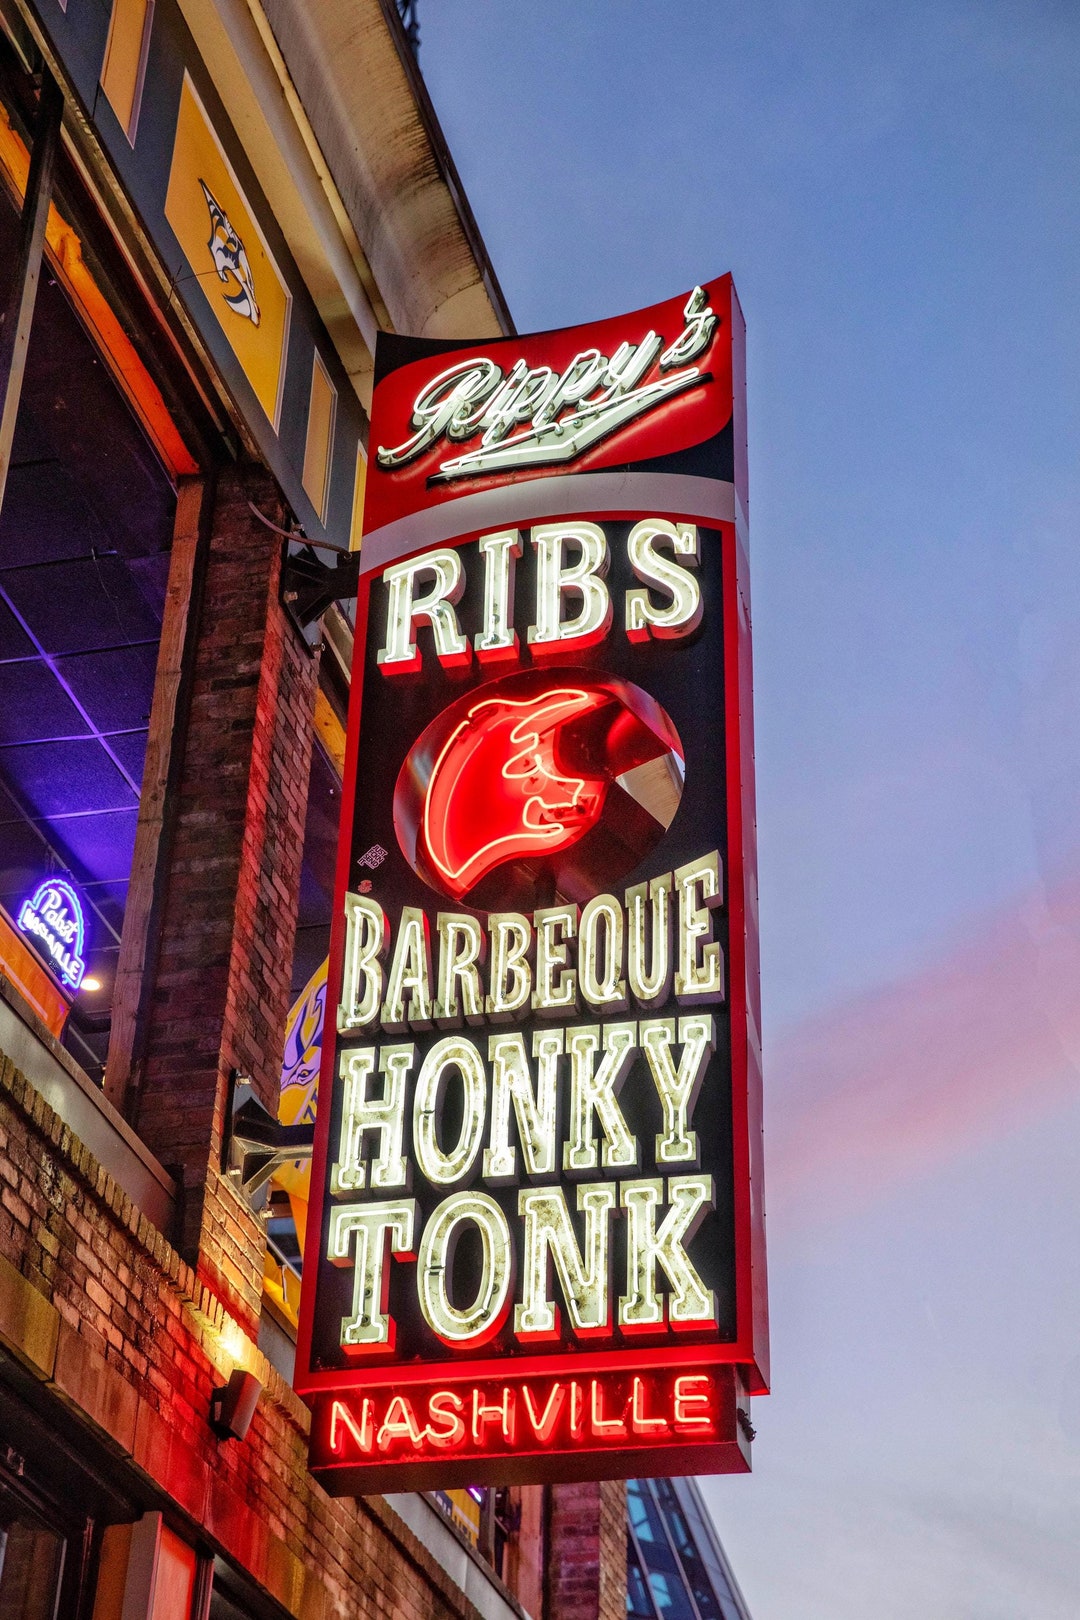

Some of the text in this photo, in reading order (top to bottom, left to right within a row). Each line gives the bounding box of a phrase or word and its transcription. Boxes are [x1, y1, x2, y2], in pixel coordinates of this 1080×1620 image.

[376, 285, 720, 470] Rippy's
[377, 518, 704, 670] RIBS
[40, 888, 79, 944] Pabst
[373, 845, 387, 857] JUST
[336, 850, 724, 1033] BARBEQUE
[330, 1014, 714, 1192] HONKY
[327, 1174, 716, 1350] TONK
[330, 1375, 714, 1453] NASHVILLE
